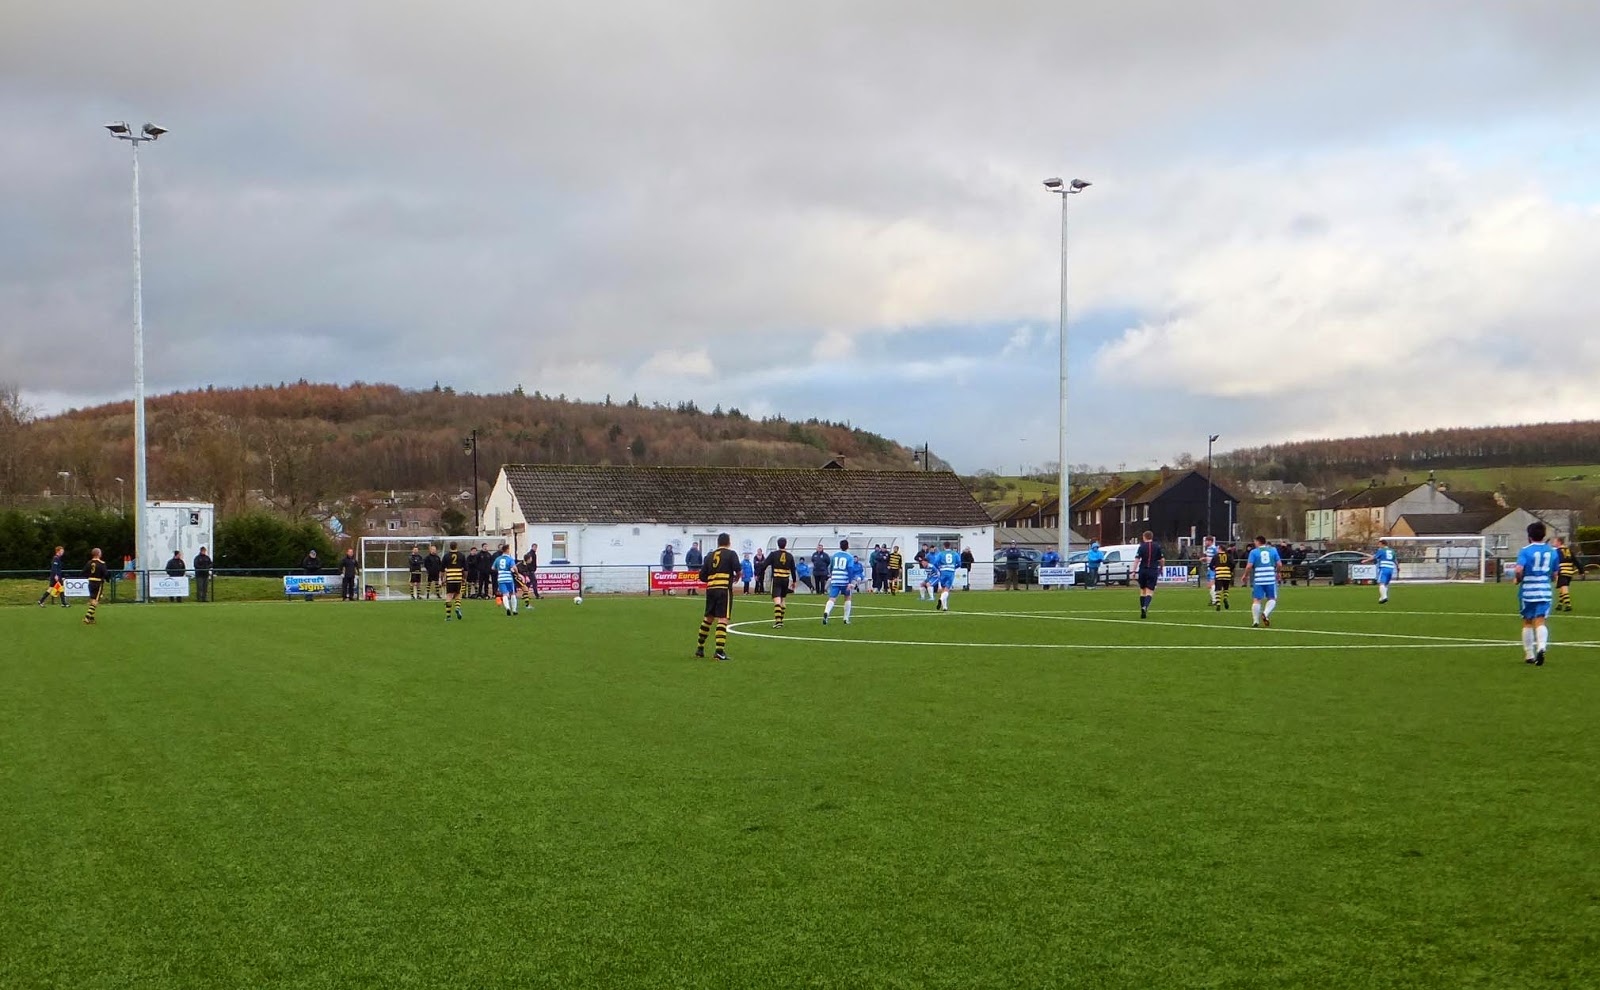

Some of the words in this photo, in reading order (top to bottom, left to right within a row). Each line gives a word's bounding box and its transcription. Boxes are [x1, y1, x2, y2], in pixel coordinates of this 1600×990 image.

[451, 553, 458, 565] 2
[712, 550, 721, 569] 5
[779, 552, 787, 565] 4
[1218, 553, 1228, 564] 10
[1260, 550, 1270, 564] 8
[1386, 549, 1393, 560] 5
[499, 558, 506, 569] 9
[833, 556, 847, 570] 10
[1532, 551, 1551, 572] 11
[90, 562, 96, 574] 3
[1166, 567, 1186, 577] HALL
[654, 572, 678, 580] Currie
[299, 583, 325, 592] Signs
